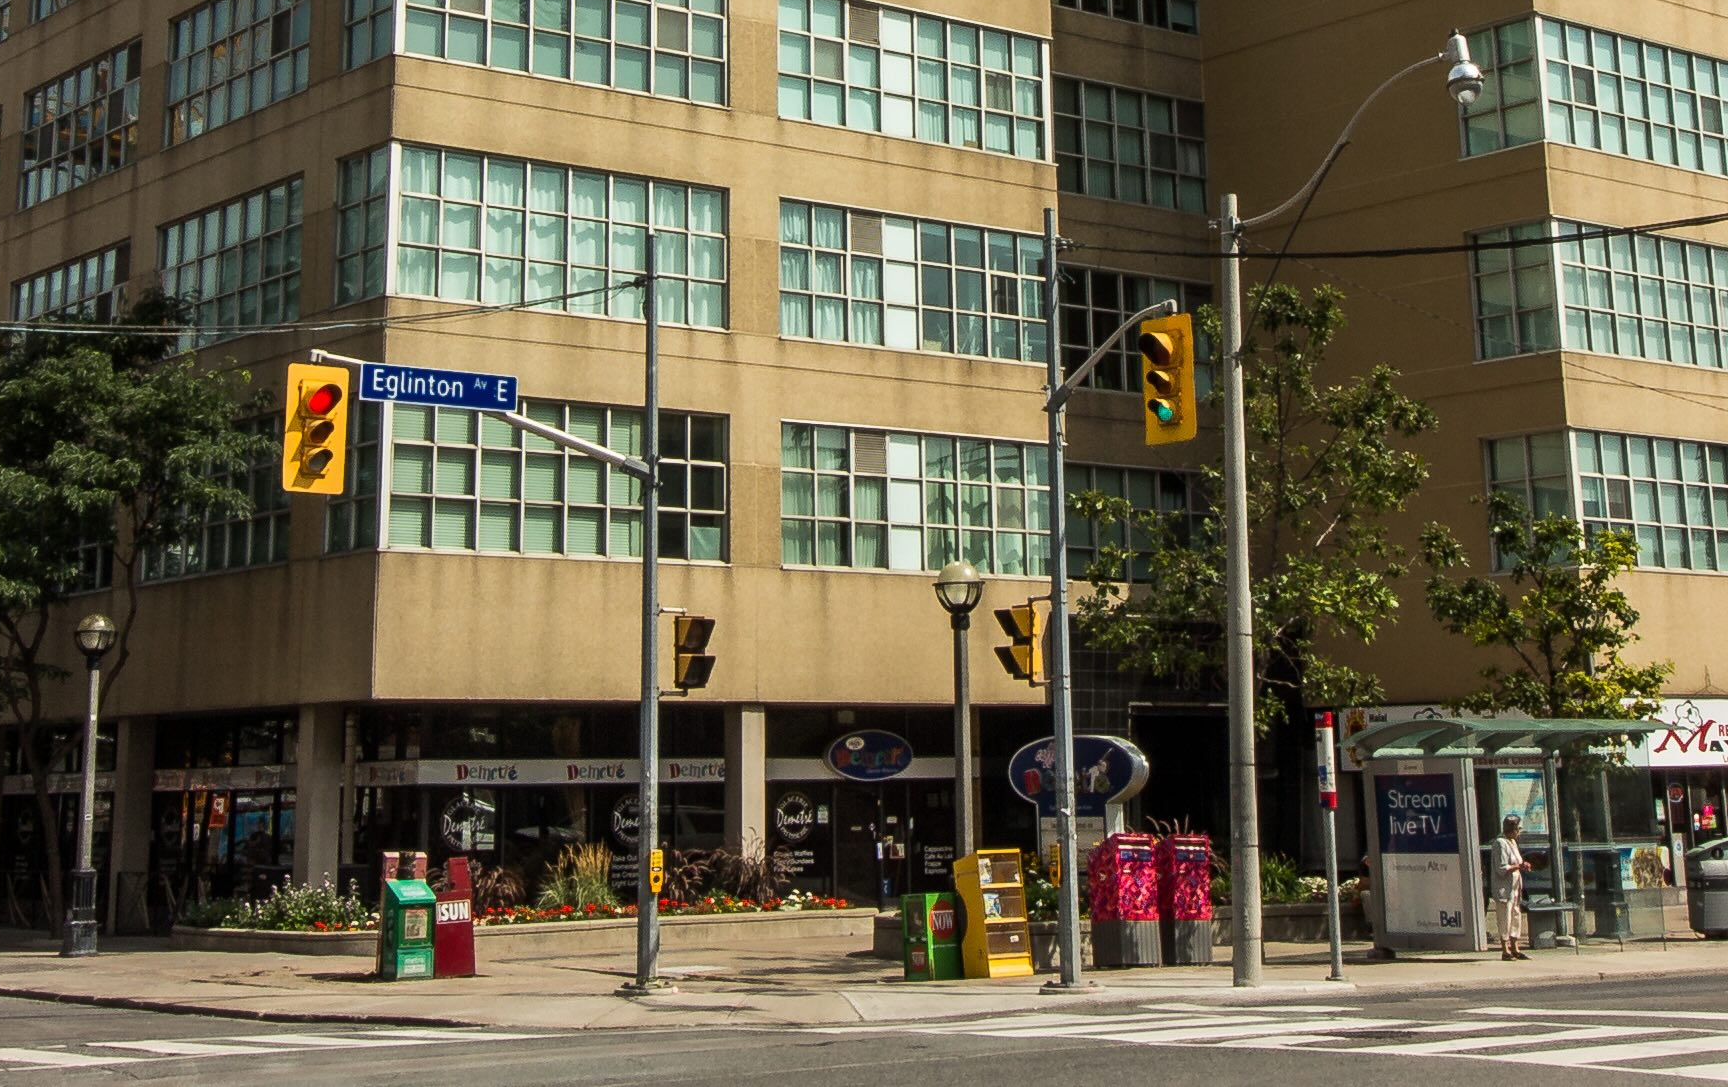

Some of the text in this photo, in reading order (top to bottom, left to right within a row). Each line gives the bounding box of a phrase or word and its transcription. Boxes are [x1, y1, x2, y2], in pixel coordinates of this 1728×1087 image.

[372, 367, 508, 402] Eglinton Av E
[1388, 790, 1447, 810] Stream
[1390, 815, 1442, 836] live TV
[440, 902, 469, 922] SUN
[933, 912, 954, 930] NOW
[1440, 910, 1462, 929] Bell
